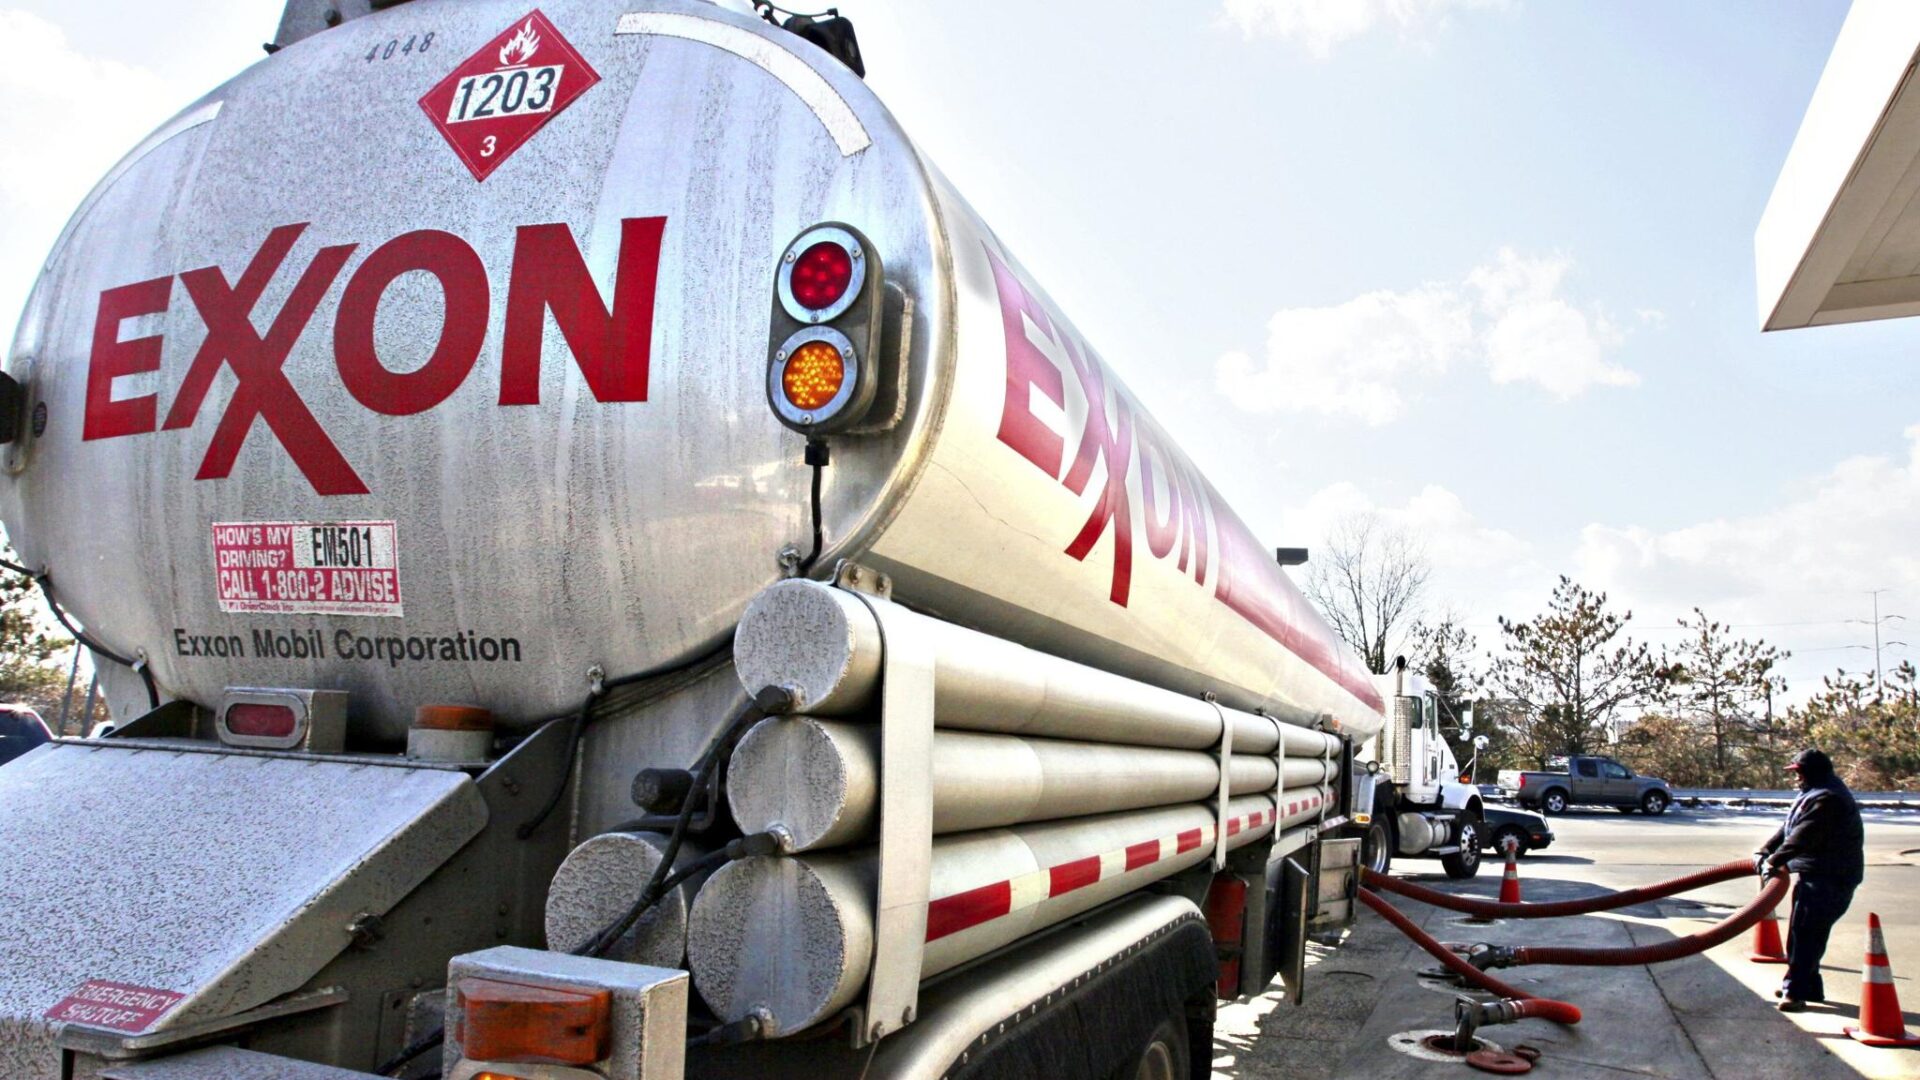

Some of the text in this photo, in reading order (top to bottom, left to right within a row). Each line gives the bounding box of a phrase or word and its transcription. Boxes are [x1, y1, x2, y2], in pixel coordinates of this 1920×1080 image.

[365, 31, 435, 63] 4048
[457, 67, 555, 120] 1203
[480, 135, 497, 157] 3
[82, 215, 668, 496] EXXON
[217, 527, 291, 546] HOW'S MY
[312, 527, 373, 567] EM501
[220, 549, 287, 568] DRIVING?
[220, 570, 395, 602] CALL 1-800-2 ADVISE
[174, 628, 522, 669] Exxon Mobil Corporation
[72, 984, 180, 1011] EMERGENCY
[61, 1003, 144, 1026] SHUTOFF
